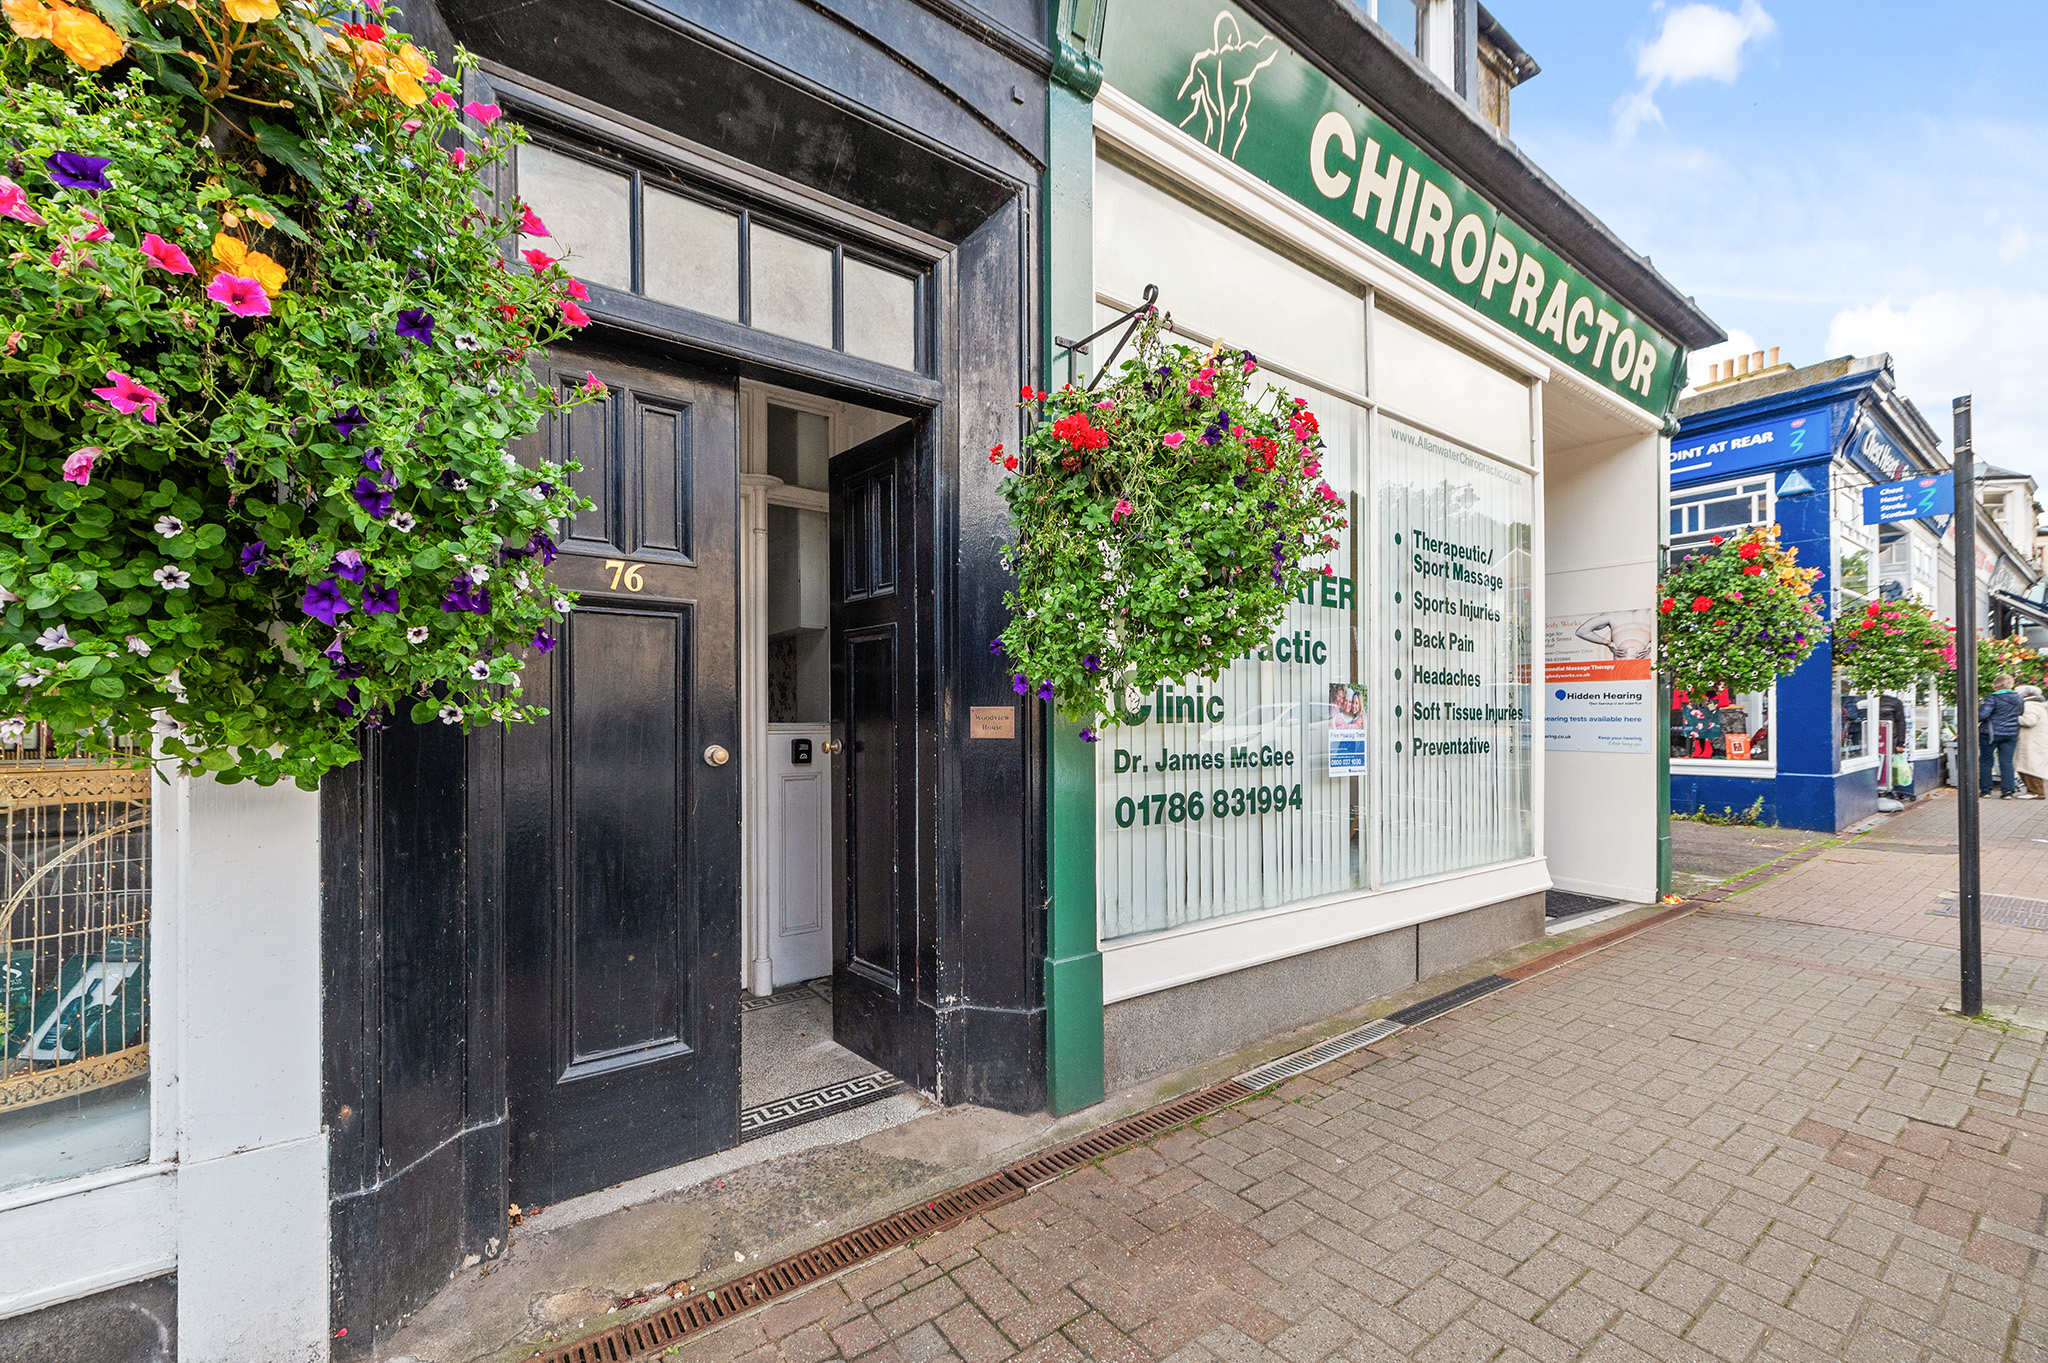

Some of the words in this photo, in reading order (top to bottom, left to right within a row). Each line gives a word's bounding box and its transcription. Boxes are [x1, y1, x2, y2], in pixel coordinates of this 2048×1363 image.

[1309, 110, 1658, 397] CHIROPRACTOR
[1706, 441, 1728, 455] AT
[1731, 431, 1774, 450] REAR
[1391, 428, 1522, 486] www.AllanwaterChiropractic.co.uk
[1880, 486, 1904, 495] Chest
[1880, 494, 1904, 504] Heart
[1880, 502, 1908, 512] Stroke
[1880, 508, 1917, 520] Scotland
[1413, 529, 1494, 566] Therapeutic/
[605, 560, 645, 592] 76
[1413, 553, 1450, 581] Sport
[1452, 563, 1504, 591] Massage
[1413, 591, 1457, 616] Sports
[1460, 599, 1501, 622] Injuries
[1561, 620, 1581, 628] Works
[1413, 628, 1446, 650] Back
[1449, 634, 1474, 653] Pain
[1413, 664, 1481, 688] Headaches
[1113, 670, 1226, 727] Clinic
[1567, 692, 1600, 700] Hidden
[1603, 691, 1642, 701] Hearing
[1413, 701, 1440, 722] Soft
[1444, 702, 1483, 721] Tissue
[1485, 703, 1524, 725] Injuries
[1413, 736, 1490, 757] Preventative
[1114, 748, 1148, 774] Dr.
[1155, 747, 1226, 773] James
[1230, 745, 1295, 769] McGee
[1115, 791, 1205, 828] 01786
[1212, 783, 1303, 819] 831994
